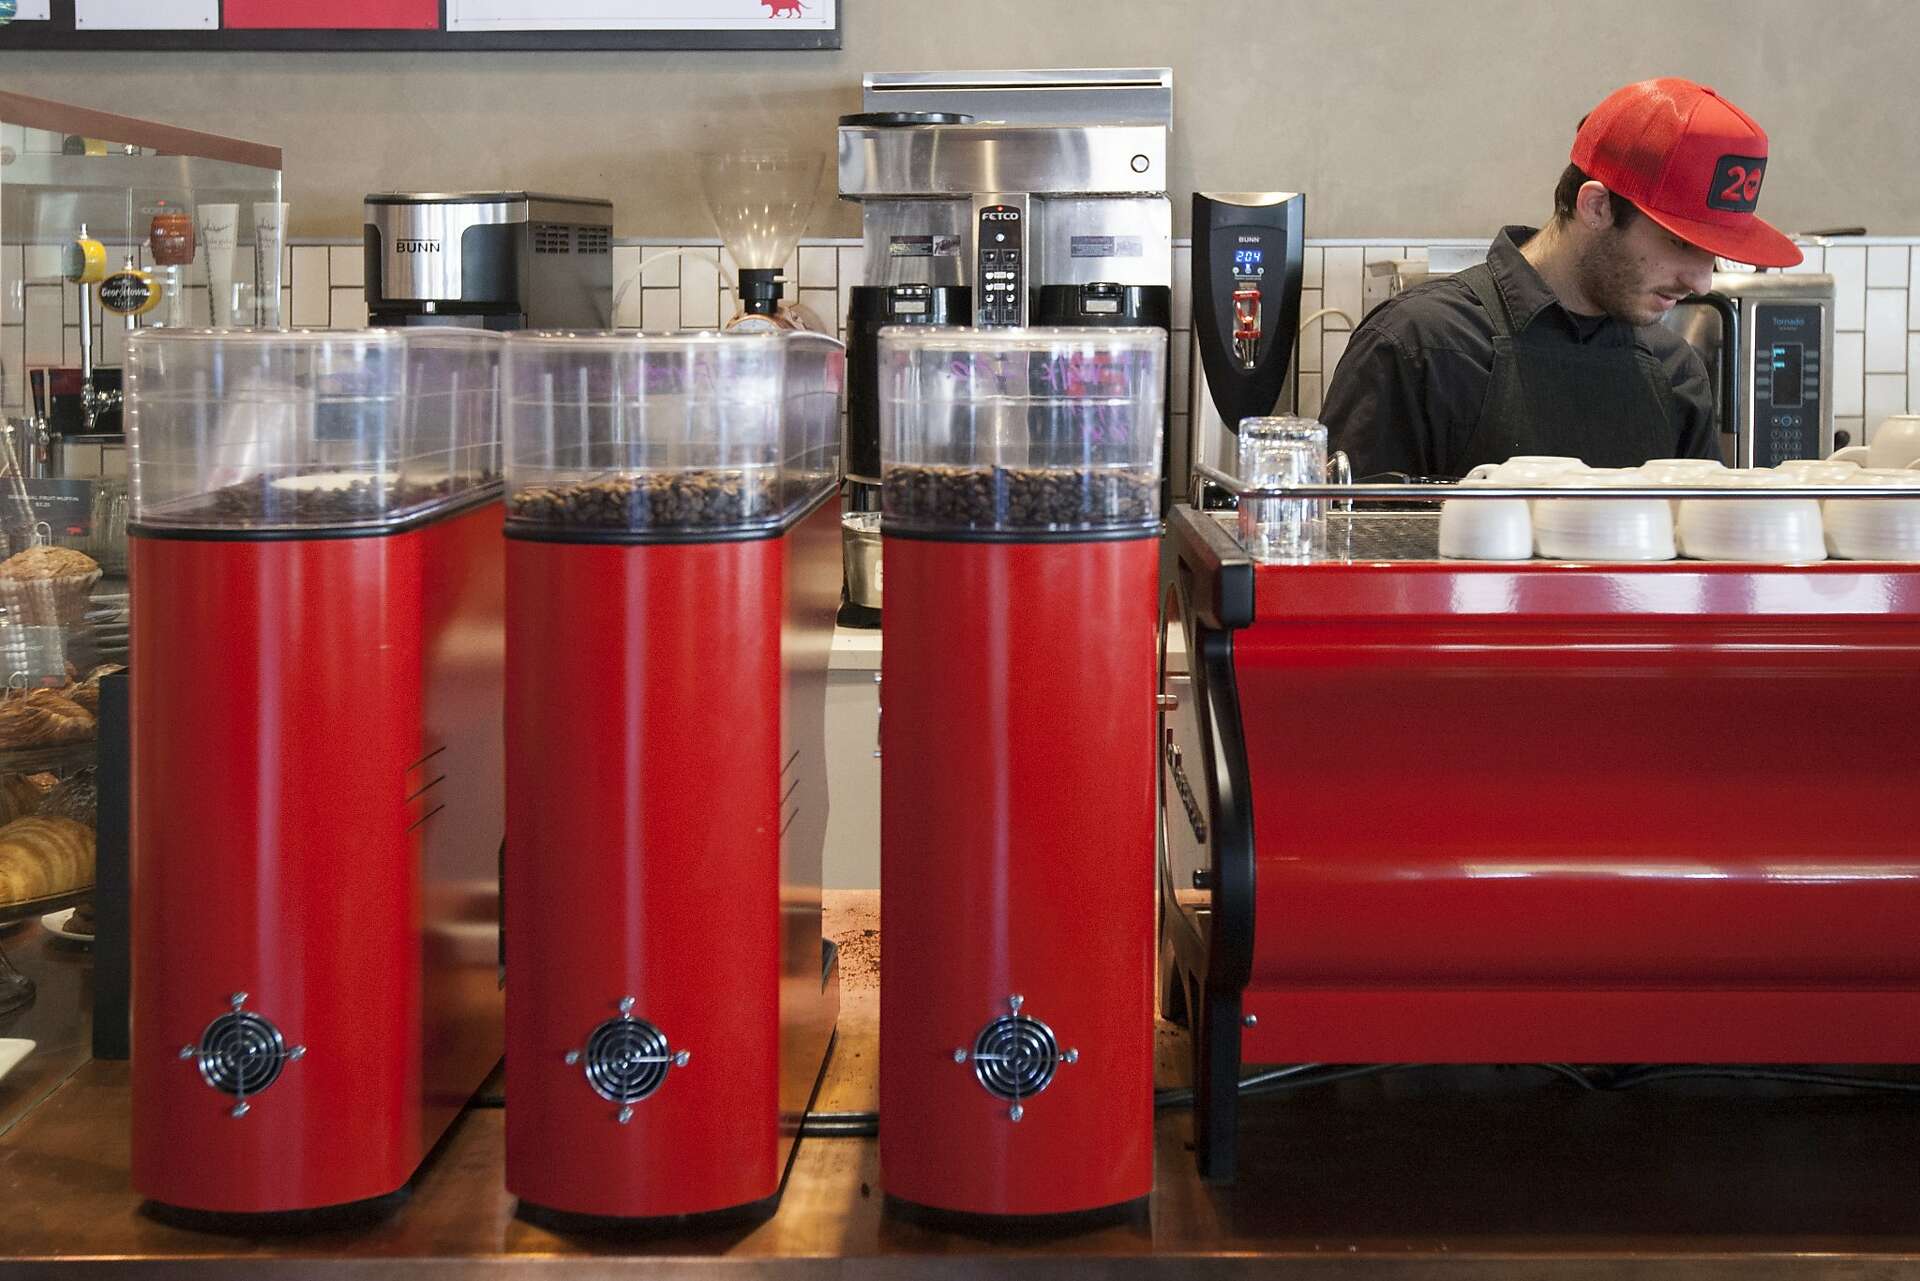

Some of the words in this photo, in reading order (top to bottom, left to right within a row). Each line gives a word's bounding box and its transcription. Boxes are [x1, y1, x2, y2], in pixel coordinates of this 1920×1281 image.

[982, 212, 1019, 220] FETCO
[396, 242, 440, 253] BUNN
[1235, 250, 1261, 262] 204
